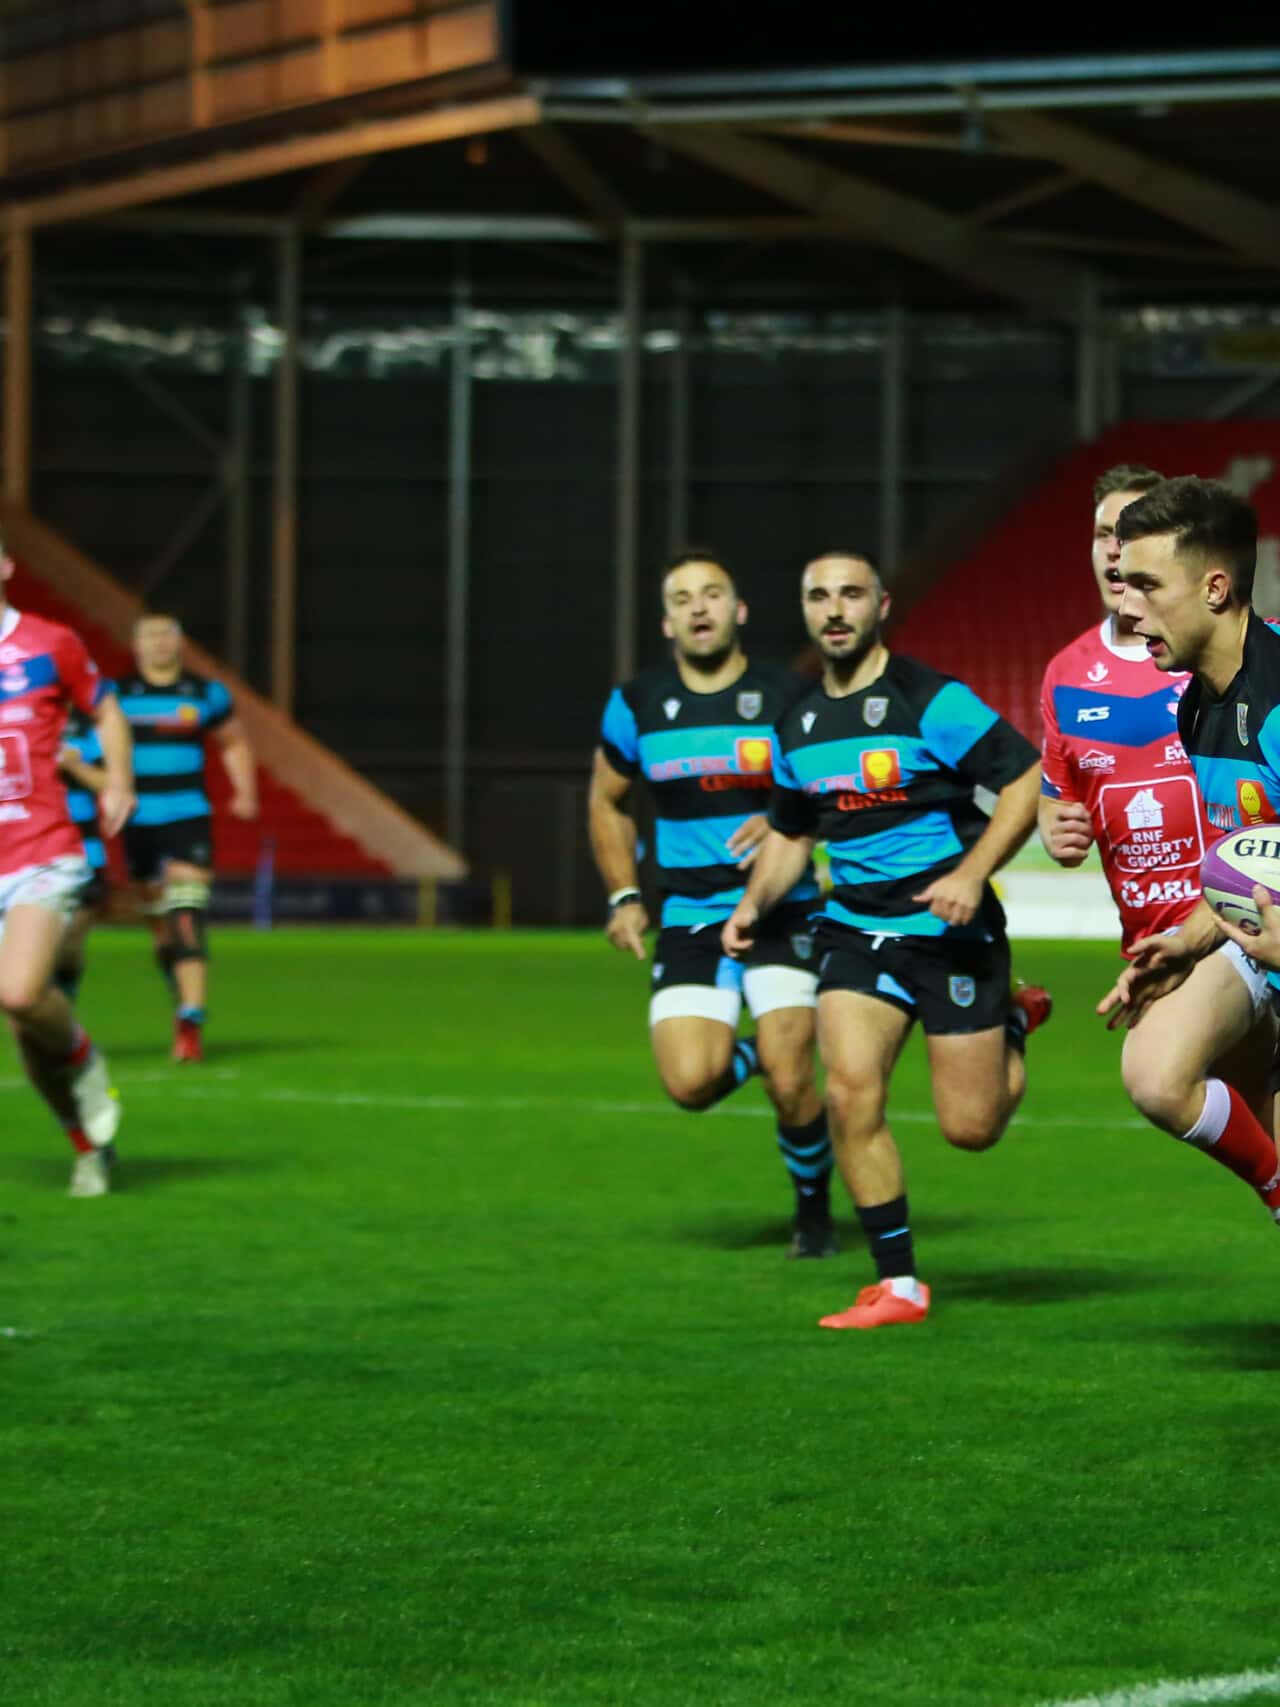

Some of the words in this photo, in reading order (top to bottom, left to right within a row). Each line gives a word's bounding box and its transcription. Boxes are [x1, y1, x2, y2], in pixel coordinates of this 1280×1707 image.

[1076, 706, 1111, 723] RCS
[1131, 830, 1164, 843] RNF
[1118, 836, 1194, 856] ROPERTY
[1127, 852, 1181, 868] GROUP
[1147, 880, 1202, 901] ARL
